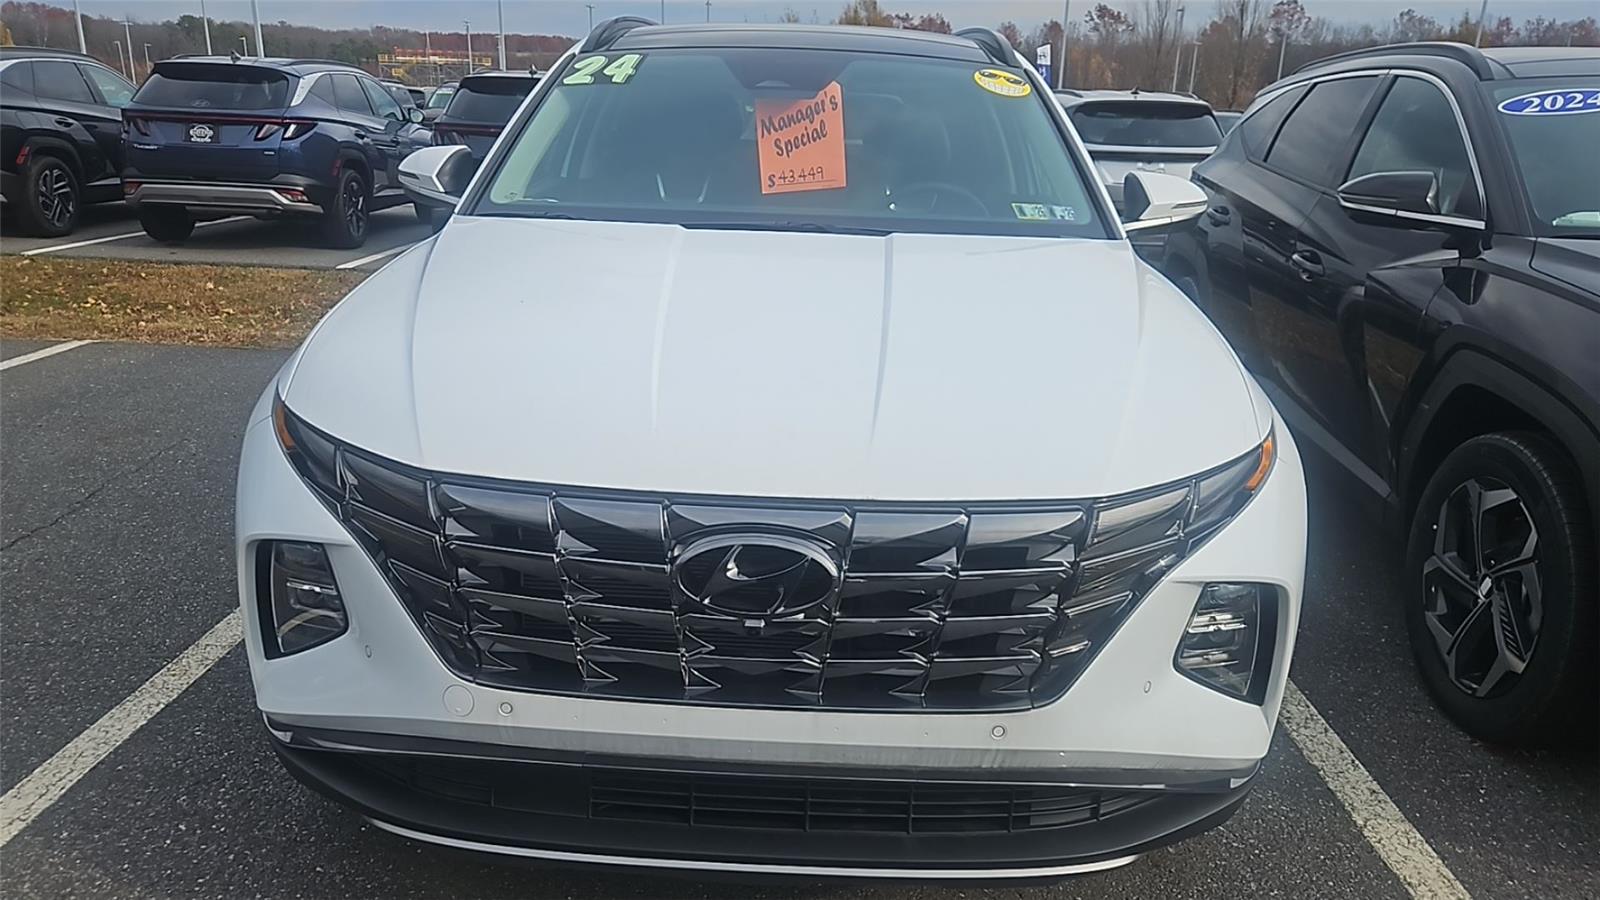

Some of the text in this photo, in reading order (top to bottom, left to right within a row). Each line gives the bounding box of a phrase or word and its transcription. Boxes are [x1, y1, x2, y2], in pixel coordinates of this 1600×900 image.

[563, 54, 643, 84] 24
[760, 91, 838, 139] Manager's
[1522, 92, 1600, 113] 2024
[773, 119, 828, 158] Special
